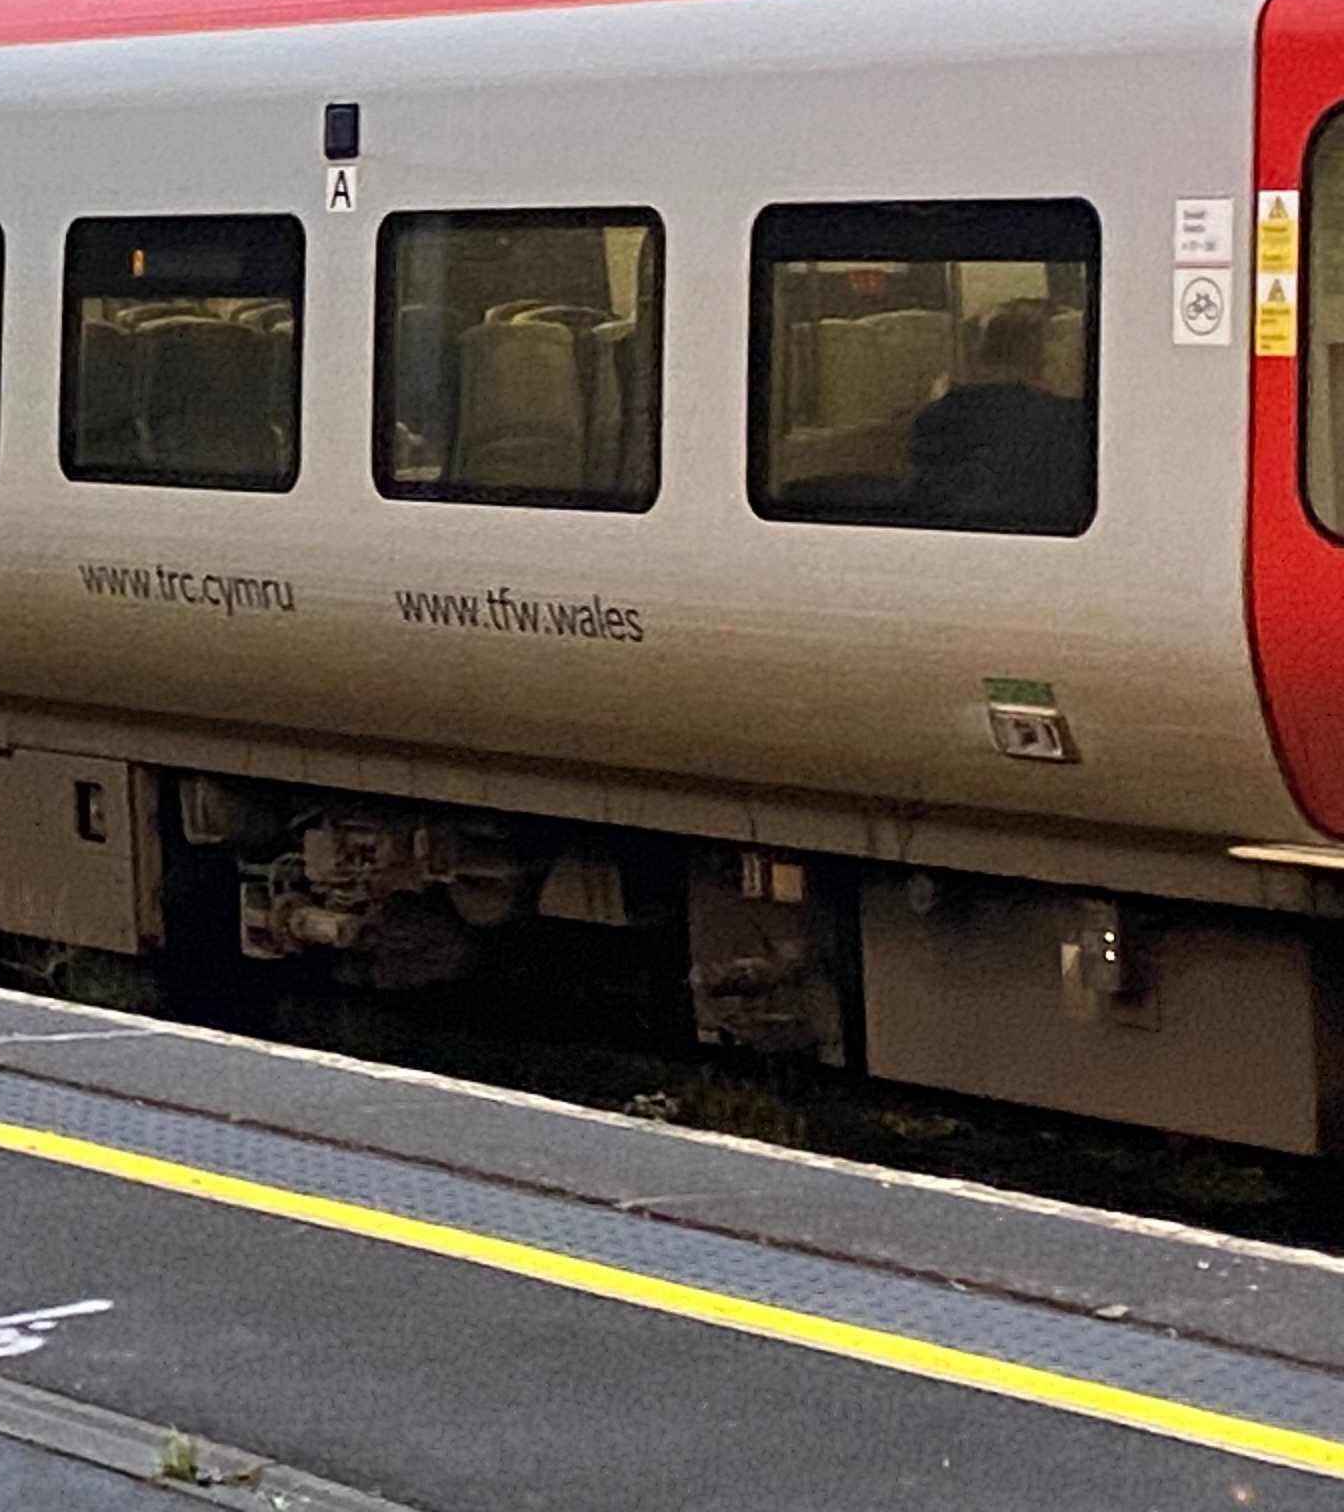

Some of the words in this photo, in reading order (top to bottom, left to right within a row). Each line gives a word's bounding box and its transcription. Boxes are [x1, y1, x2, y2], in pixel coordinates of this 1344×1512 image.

[330, 169, 351, 209] A
[79, 562, 296, 616] www.trc.cymru
[395, 585, 644, 643] www.tfw.wales
